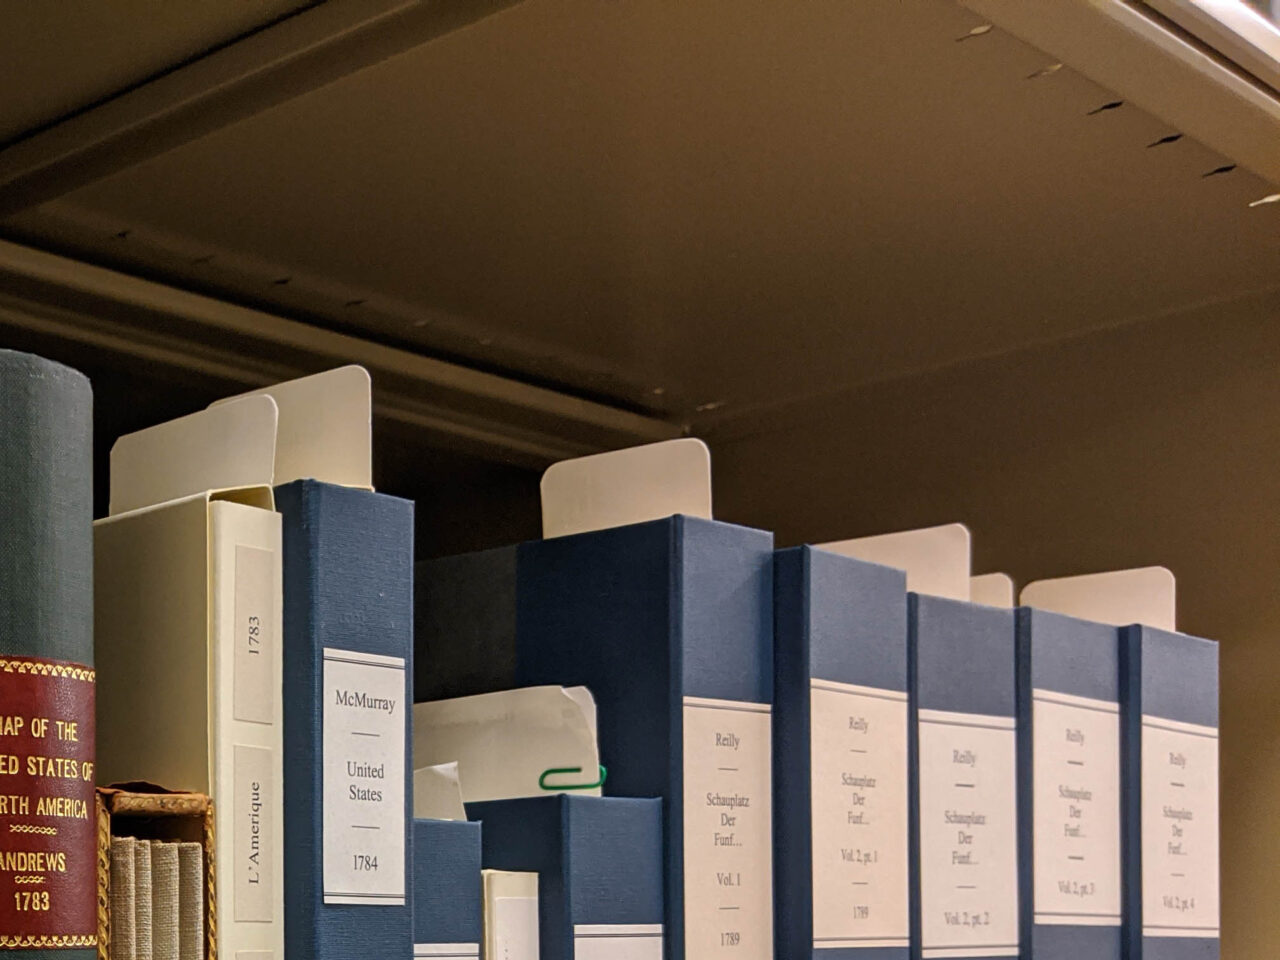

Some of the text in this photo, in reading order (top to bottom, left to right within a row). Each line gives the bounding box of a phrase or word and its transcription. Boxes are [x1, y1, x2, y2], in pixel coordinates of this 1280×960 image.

[248, 616, 260, 655] 1783
[335, 690, 396, 714] McMurray
[31, 718, 49, 738] OF
[56, 721, 78, 742] THE
[715, 733, 740, 750] Reilly
[27, 757, 78, 779] STATES
[82, 762, 93, 781] OF
[347, 761, 384, 779] United
[349, 785, 382, 801] States
[706, 793, 750, 810] Schauplatz
[36, 797, 88, 819] AMERICA
[720, 813, 736, 826] Der
[353, 854, 378, 871] 1784
[717, 872, 741, 886] Vol. 1
[14, 891, 50, 911] 1783
[720, 932, 740, 946] 1789
